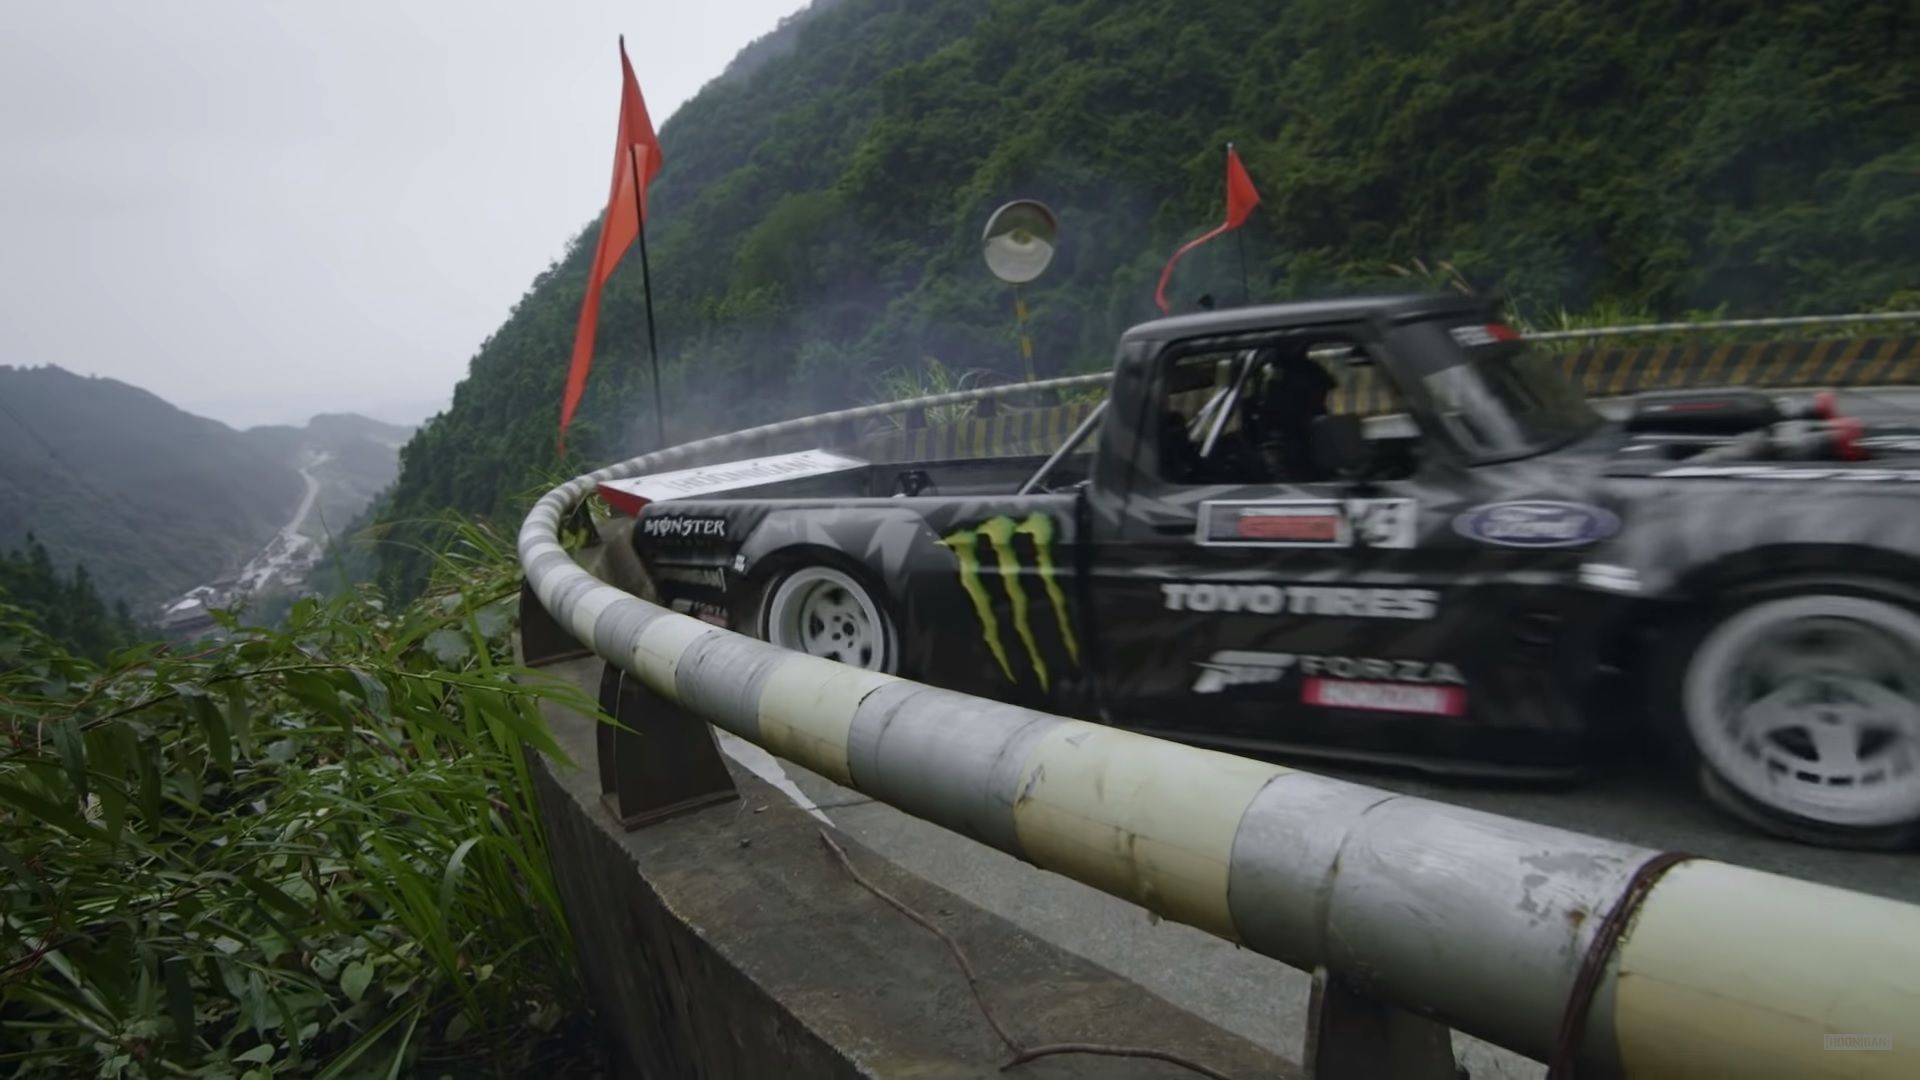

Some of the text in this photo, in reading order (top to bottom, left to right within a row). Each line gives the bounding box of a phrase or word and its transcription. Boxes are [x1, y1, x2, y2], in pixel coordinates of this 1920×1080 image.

[644, 516, 725, 537] MONSTER
[1161, 583, 1439, 620] TOYO TIRES
[1299, 655, 1467, 684] FORZA
